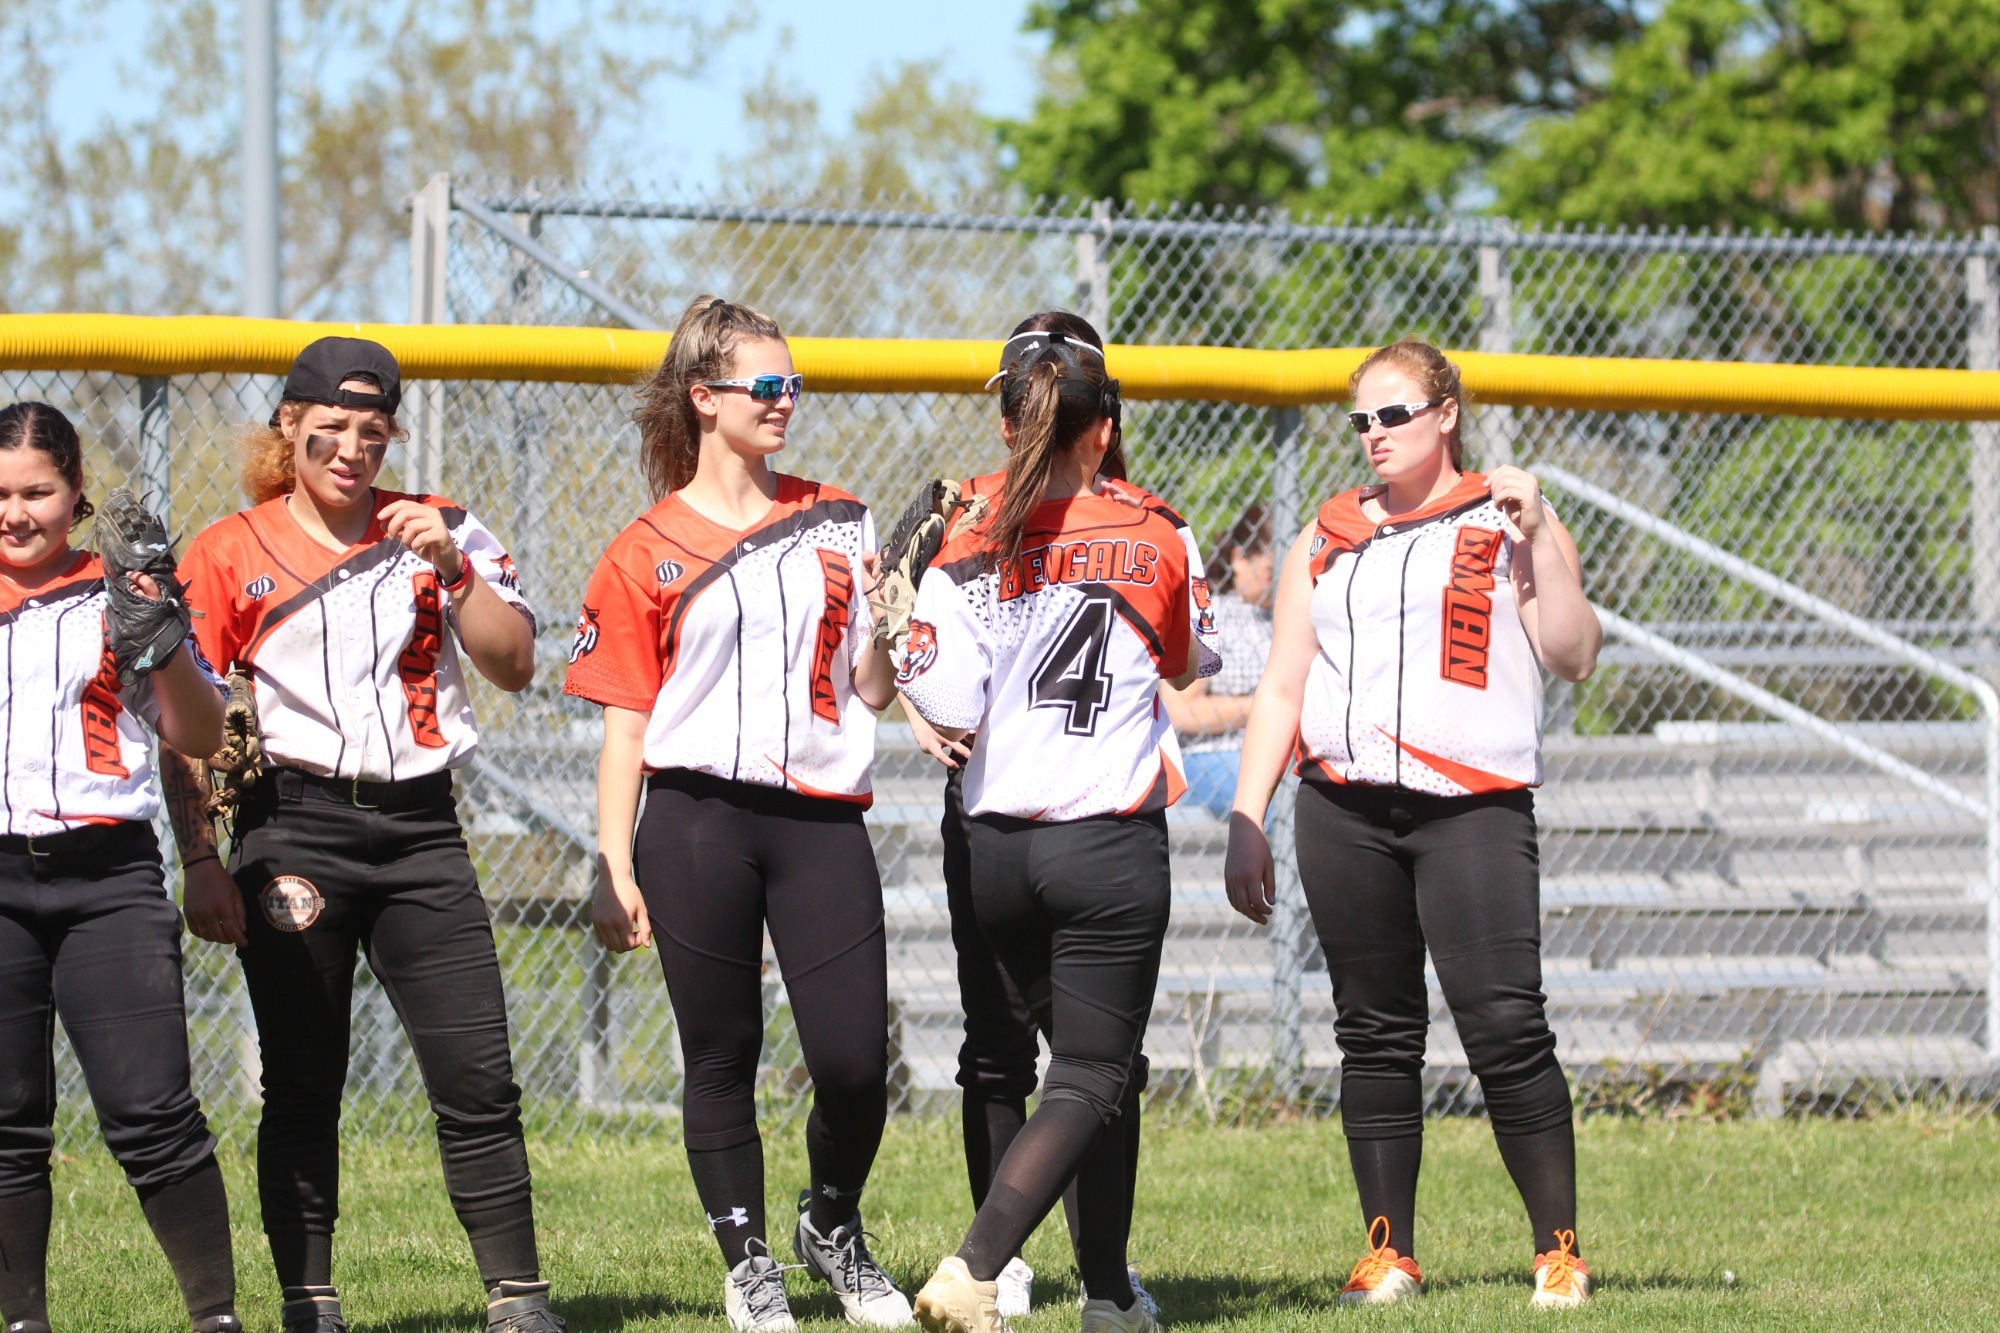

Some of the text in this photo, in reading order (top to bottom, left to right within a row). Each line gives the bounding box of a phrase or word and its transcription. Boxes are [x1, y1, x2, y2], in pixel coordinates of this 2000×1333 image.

[996, 538, 1160, 603] BENGALS
[1440, 525, 1505, 691] DIMAN
[397, 570, 450, 750] DIMAN
[1027, 595, 1116, 738] 4
